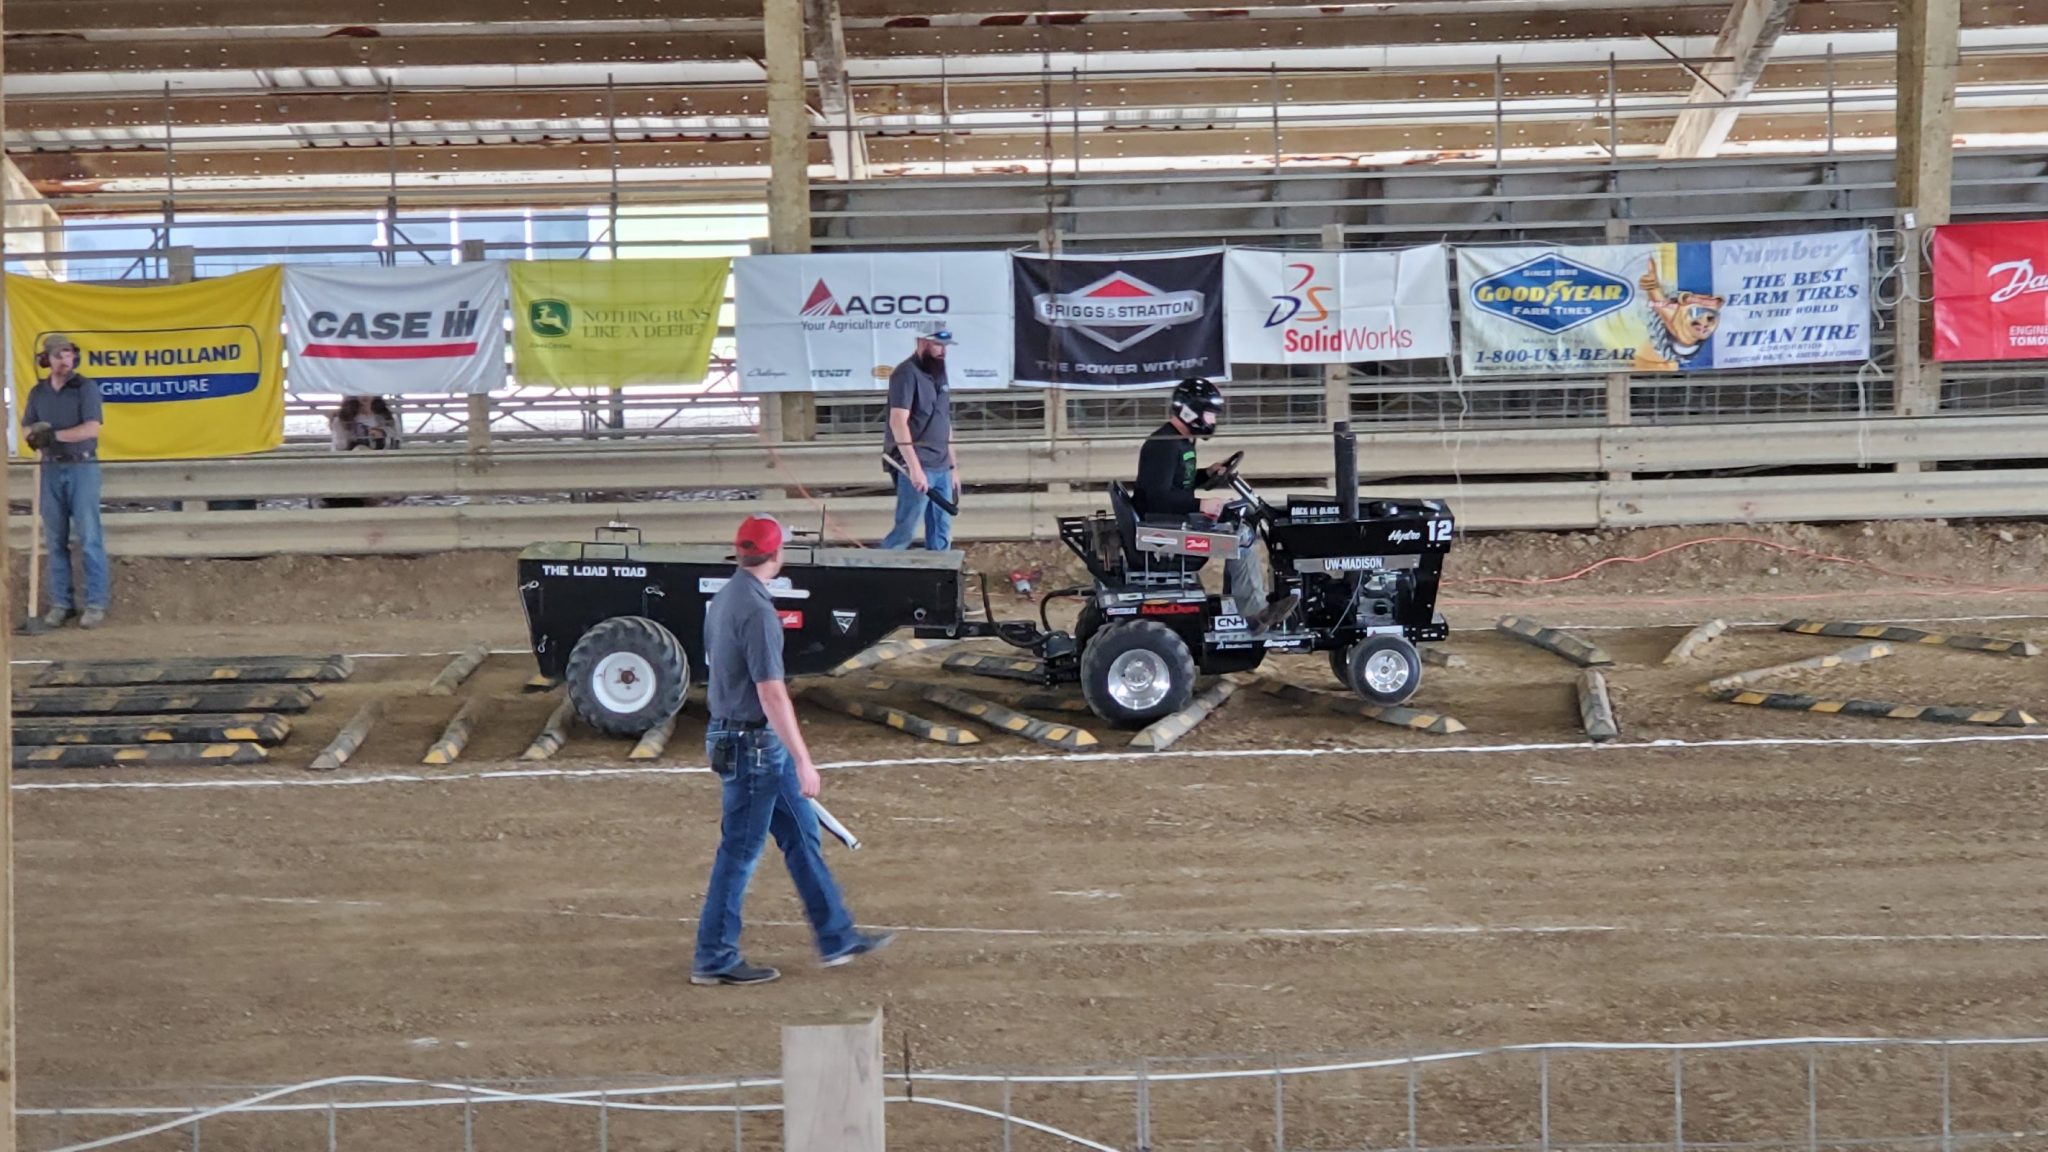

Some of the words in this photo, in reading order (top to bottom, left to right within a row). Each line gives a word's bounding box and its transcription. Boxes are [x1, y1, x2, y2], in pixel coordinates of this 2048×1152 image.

[1720, 241, 1839, 265] Number
[1742, 274, 1786, 290] THE
[1792, 267, 1848, 286] BEST
[1477, 280, 1623, 306] GOODYEAR
[1726, 291, 1789, 307] FARM
[1797, 284, 1860, 303] TIRES
[845, 295, 950, 315] AGCO
[1512, 306, 1550, 315] FARM
[1554, 306, 1593, 315] TIRES
[1748, 310, 1764, 319] IN
[1767, 307, 1792, 318] THE
[1796, 304, 1838, 314] WORLD
[583, 308, 661, 323] NOTHING
[667, 307, 711, 322] RUNS
[307, 311, 433, 340] CASE
[583, 325, 621, 339] LIKE
[626, 325, 639, 338] A
[801, 320, 825, 332] Your
[829, 319, 891, 333] Agriculture
[1284, 325, 1413, 353] SolidWorks
[1725, 326, 1797, 348] TITAN
[1801, 323, 1860, 341] TIRE
[2009, 336, 2048, 346] TOMO
[88, 350, 138, 366] NEW
[145, 344, 241, 366] HOLLAND
[1474, 347, 1637, 363] 1-800-USA-BEAR
[1036, 360, 1068, 372] THE
[1075, 363, 1138, 374] POWER
[100, 378, 210, 396] GRICULTURE
[1388, 529, 1421, 545] Hydro
[1427, 520, 1452, 541] 12
[542, 565, 569, 576] THE
[573, 566, 607, 577] LOAD
[612, 566, 647, 577] TOAD
[1324, 557, 1383, 571] UW-MADISON
[1217, 617, 1245, 627] CNH
